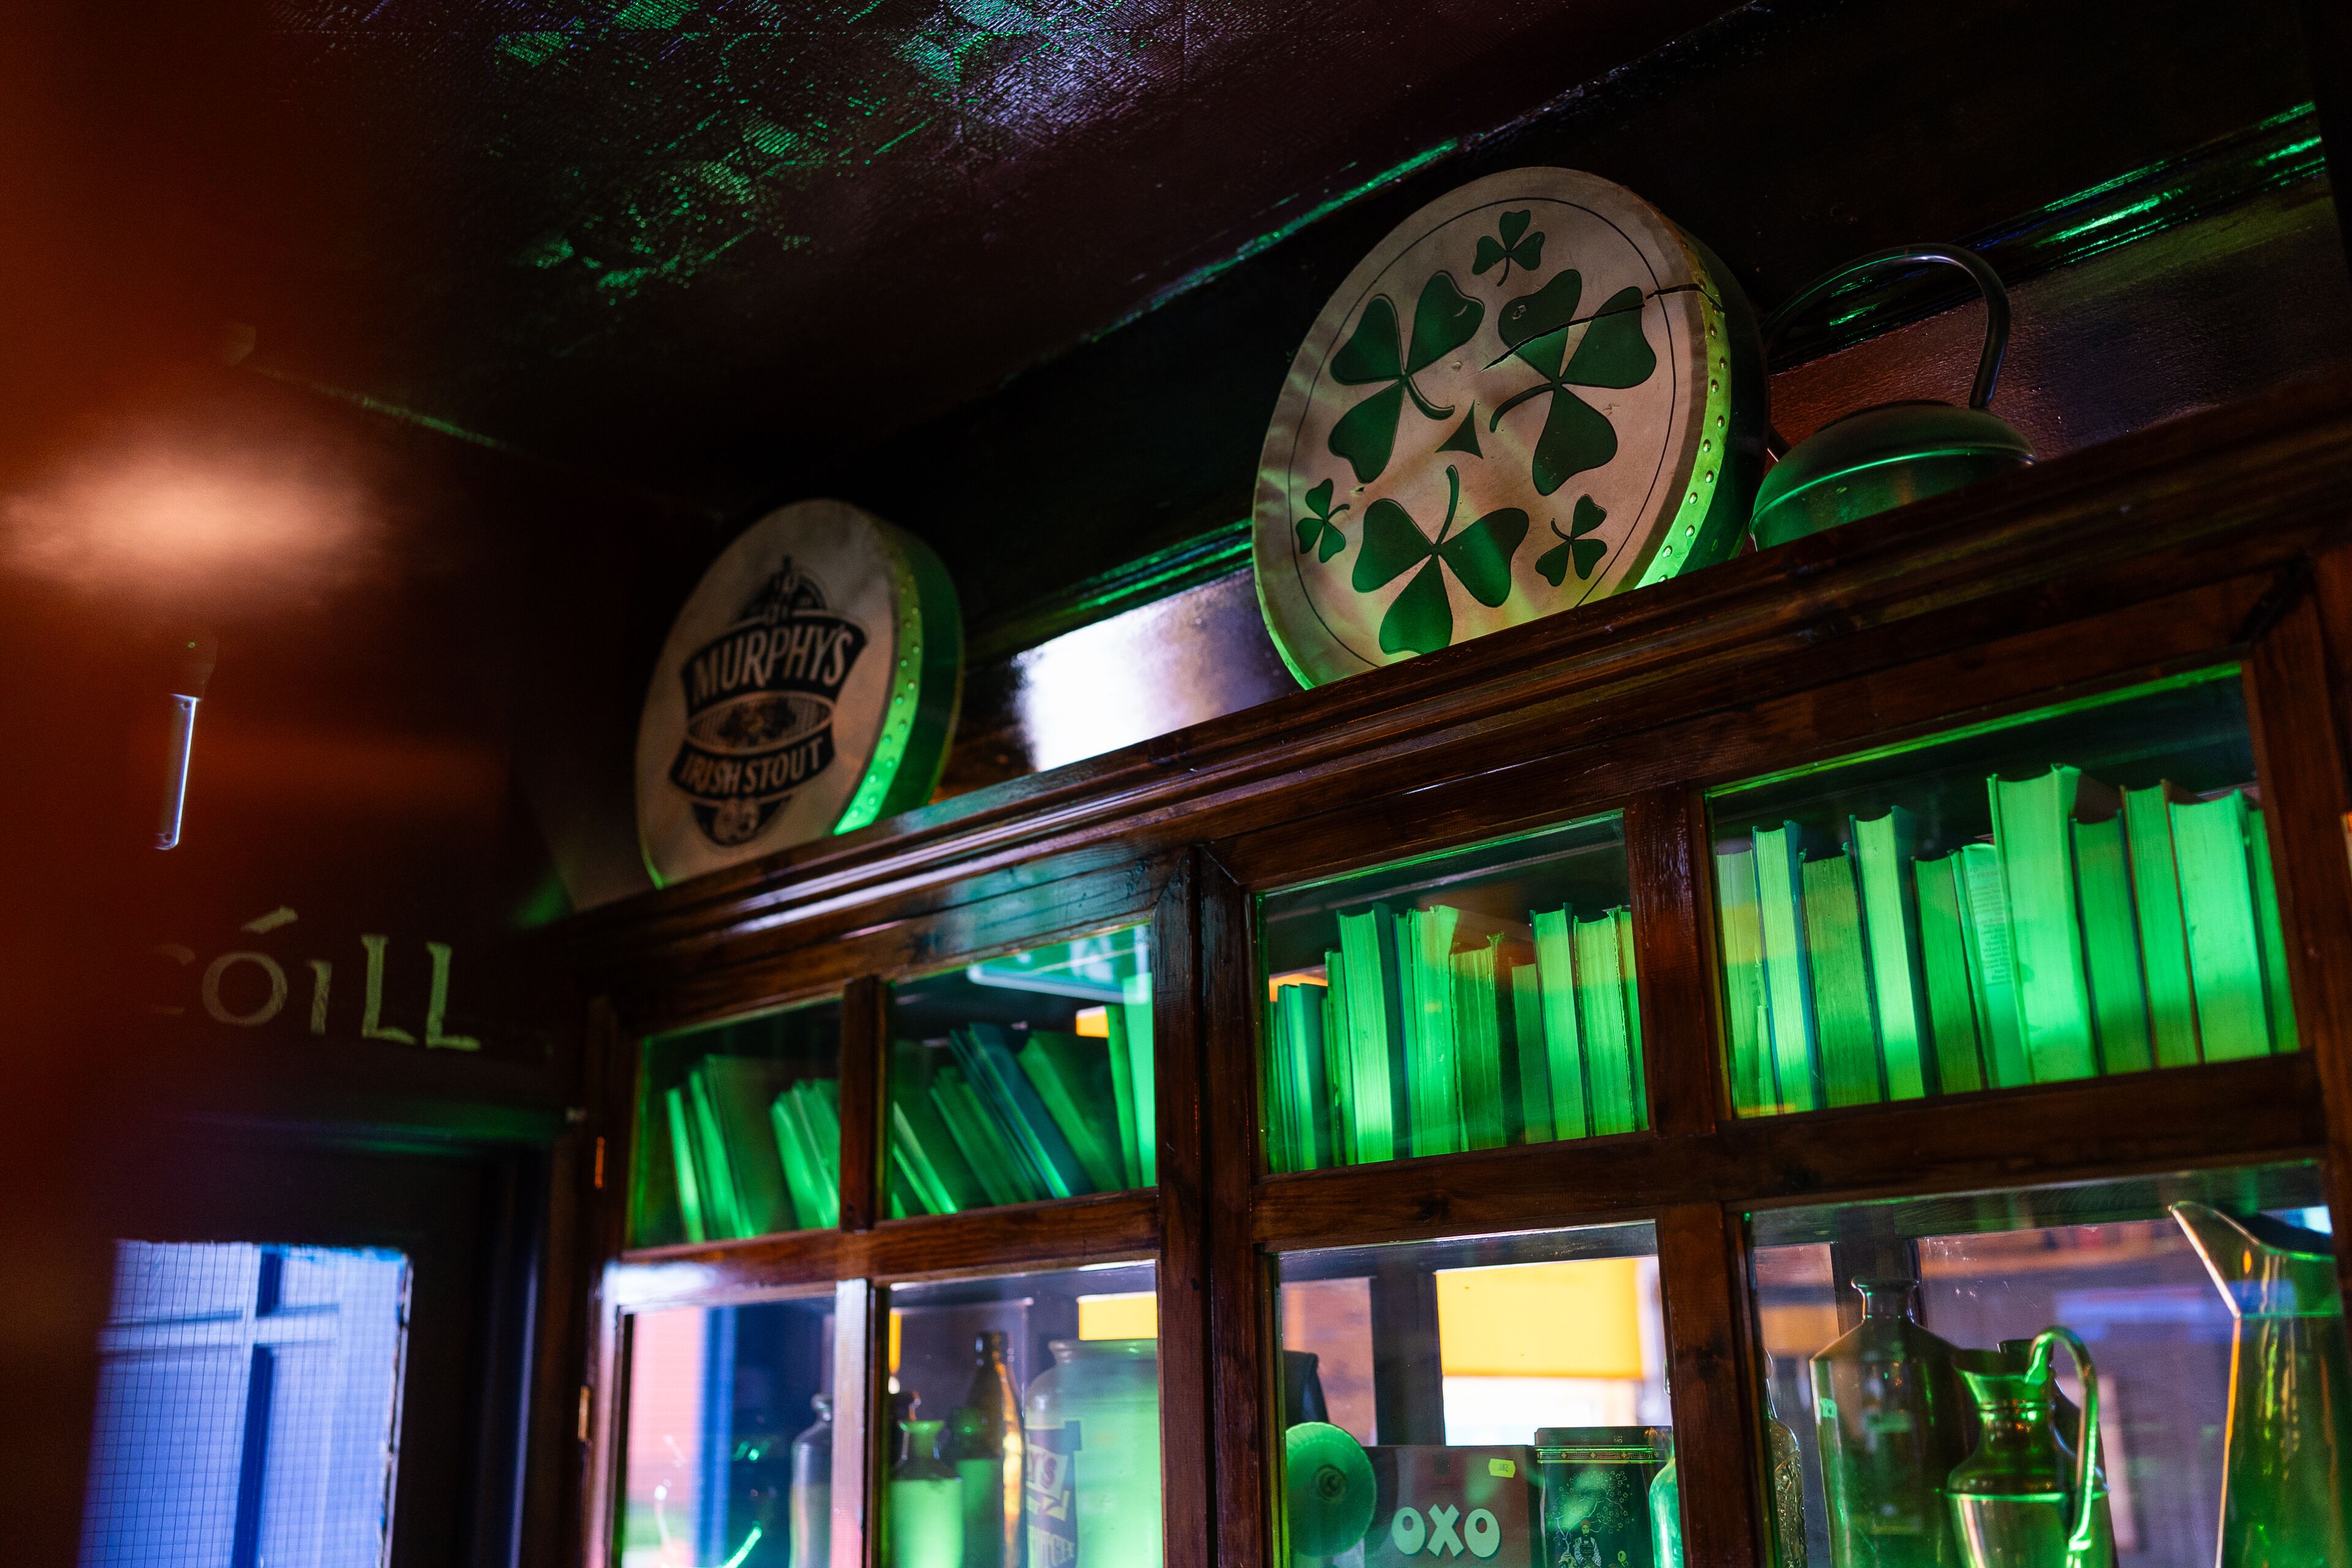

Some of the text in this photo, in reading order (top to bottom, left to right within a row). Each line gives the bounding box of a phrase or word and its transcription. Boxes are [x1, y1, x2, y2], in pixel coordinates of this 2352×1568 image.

[679, 736, 824, 794] IRISH STOUT
[1391, 1504, 1501, 1559] OXO
